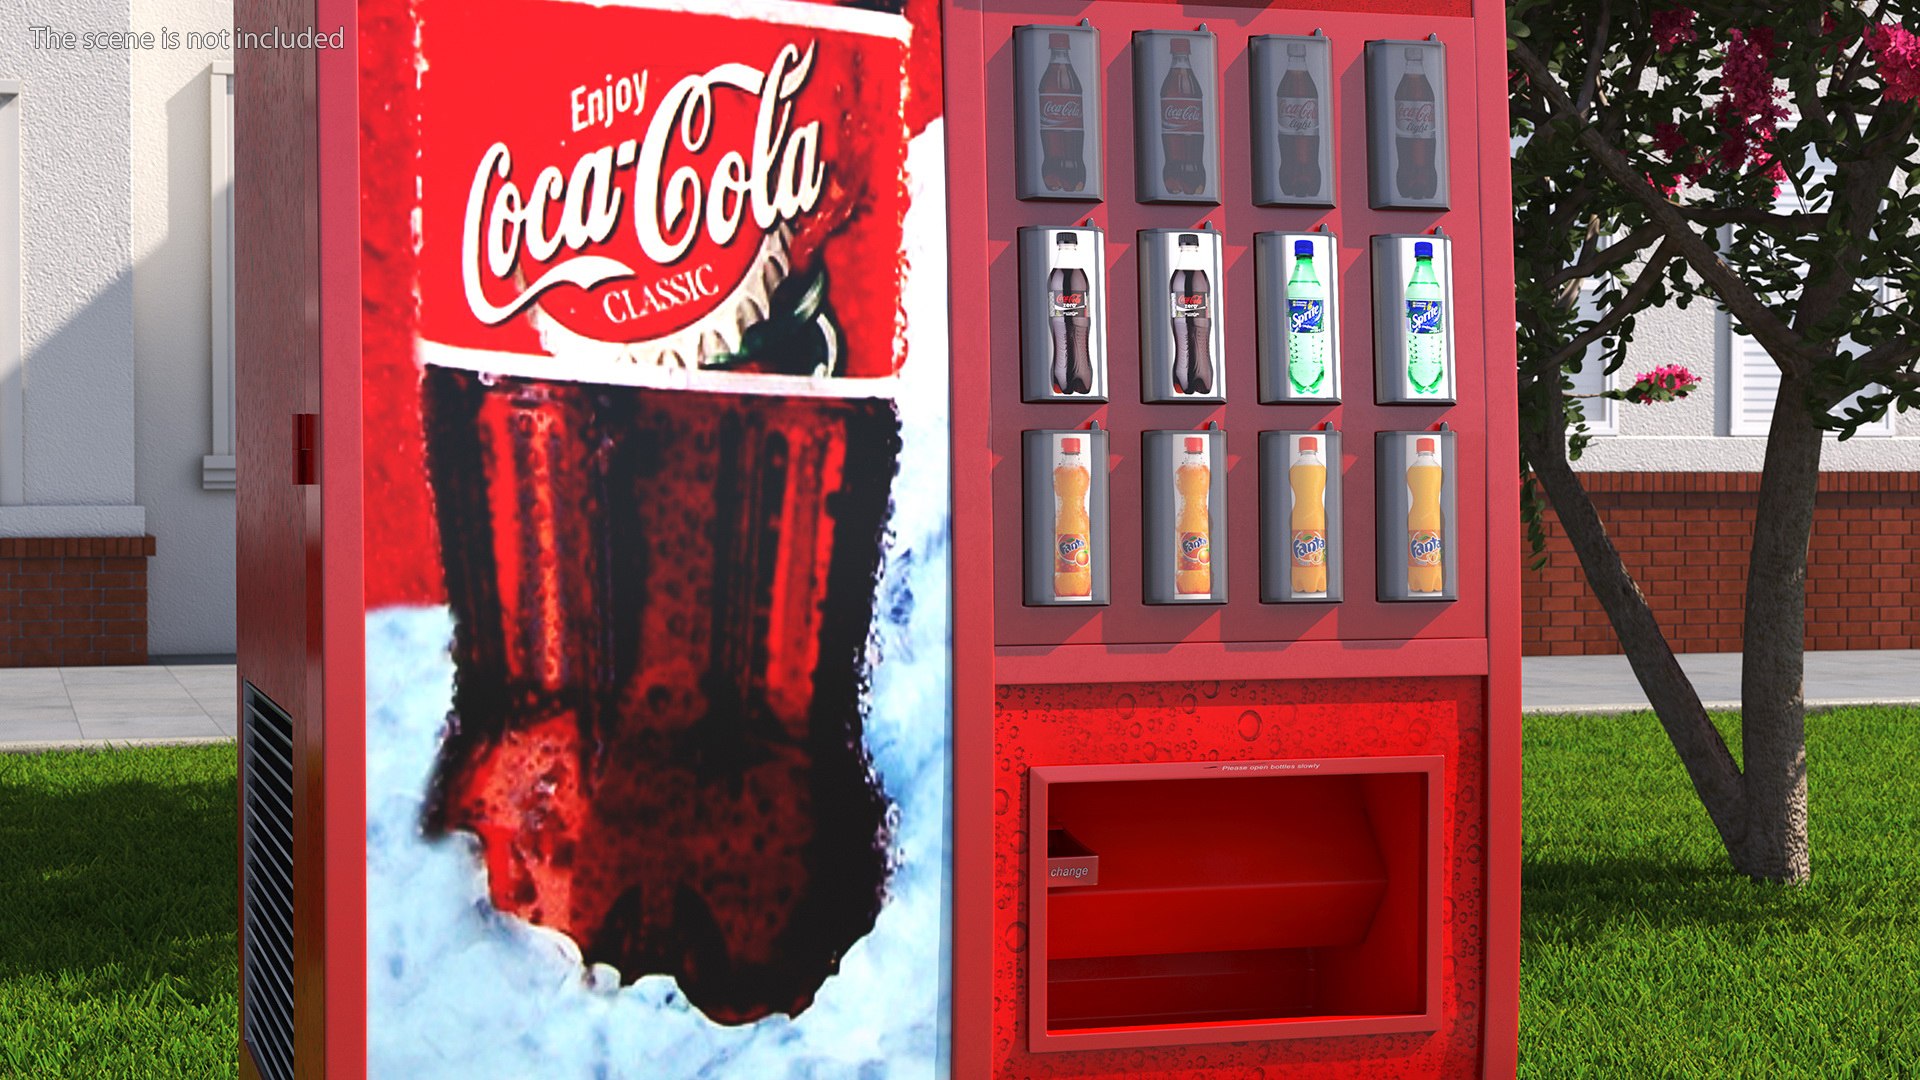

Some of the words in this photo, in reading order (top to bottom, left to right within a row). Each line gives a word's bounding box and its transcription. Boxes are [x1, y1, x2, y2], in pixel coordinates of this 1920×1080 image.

[571, 69, 648, 133] Enjoy
[462, 39, 825, 325] Coca-Cola
[603, 265, 719, 324] CLASSIC
[1292, 305, 1320, 329] Sprite
[1412, 305, 1440, 330] Sprite
[1293, 536, 1326, 559] Fanta
[1410, 536, 1442, 559] Fanta
[1050, 866, 1089, 878] change
